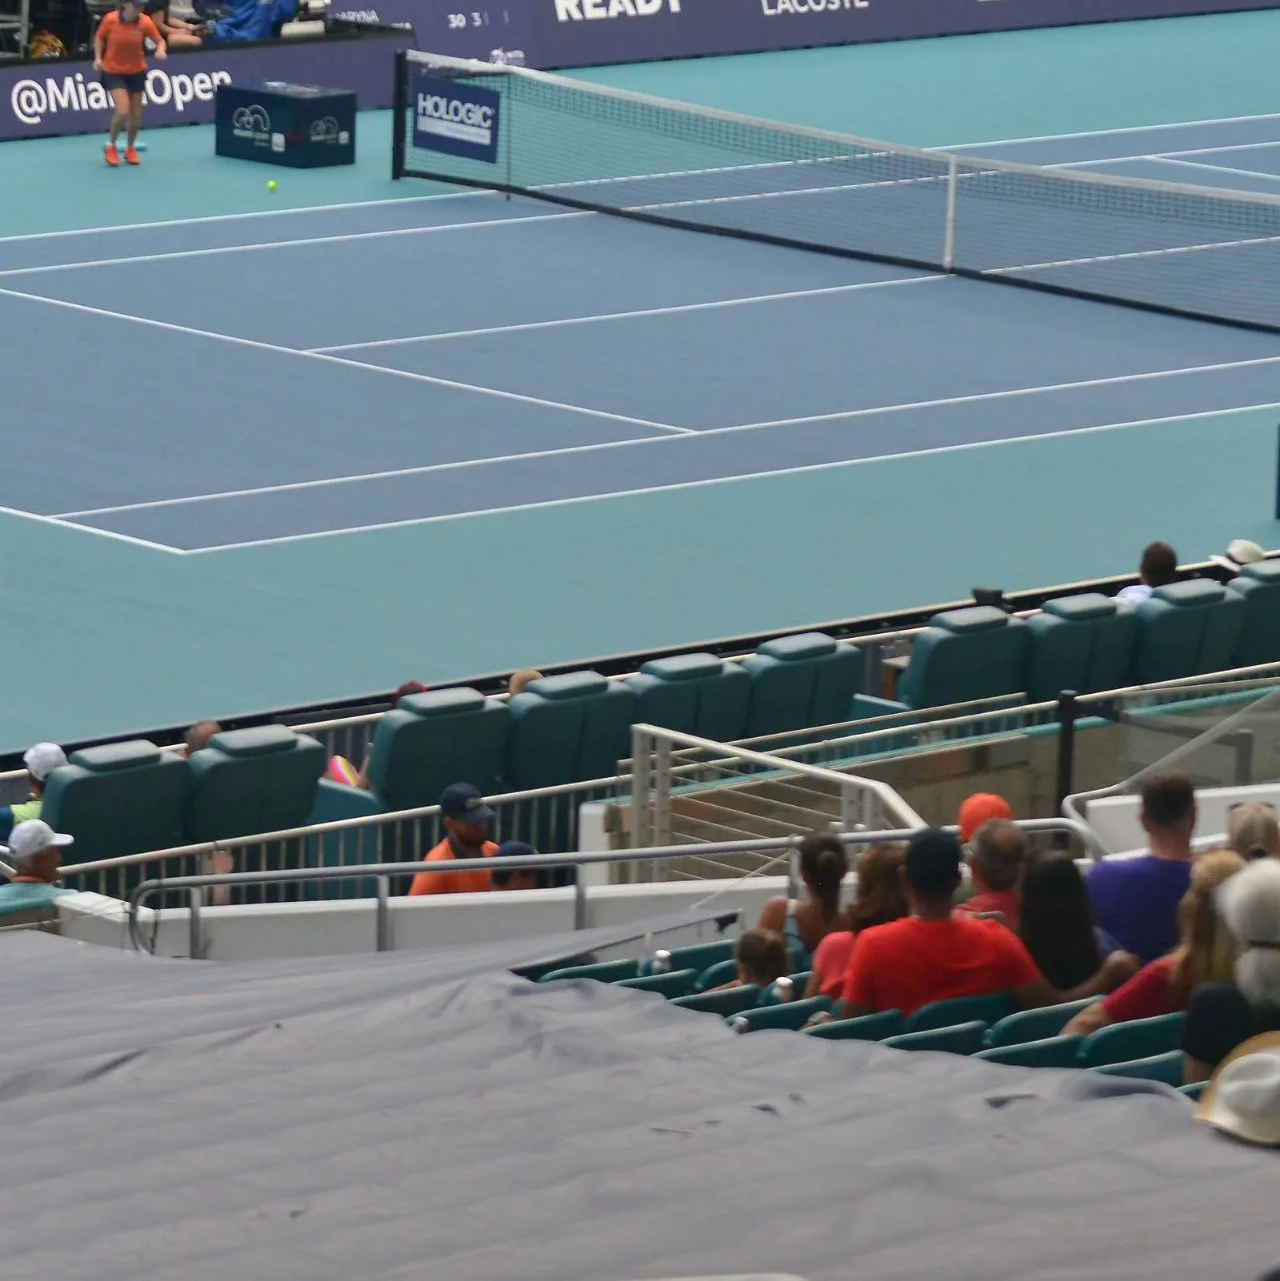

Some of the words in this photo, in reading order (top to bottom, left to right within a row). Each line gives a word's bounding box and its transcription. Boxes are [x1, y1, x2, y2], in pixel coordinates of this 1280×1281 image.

[448, 14, 466, 29] 30
[472, 12, 482, 28] 3
[417, 93, 493, 129] HOLOGIC
